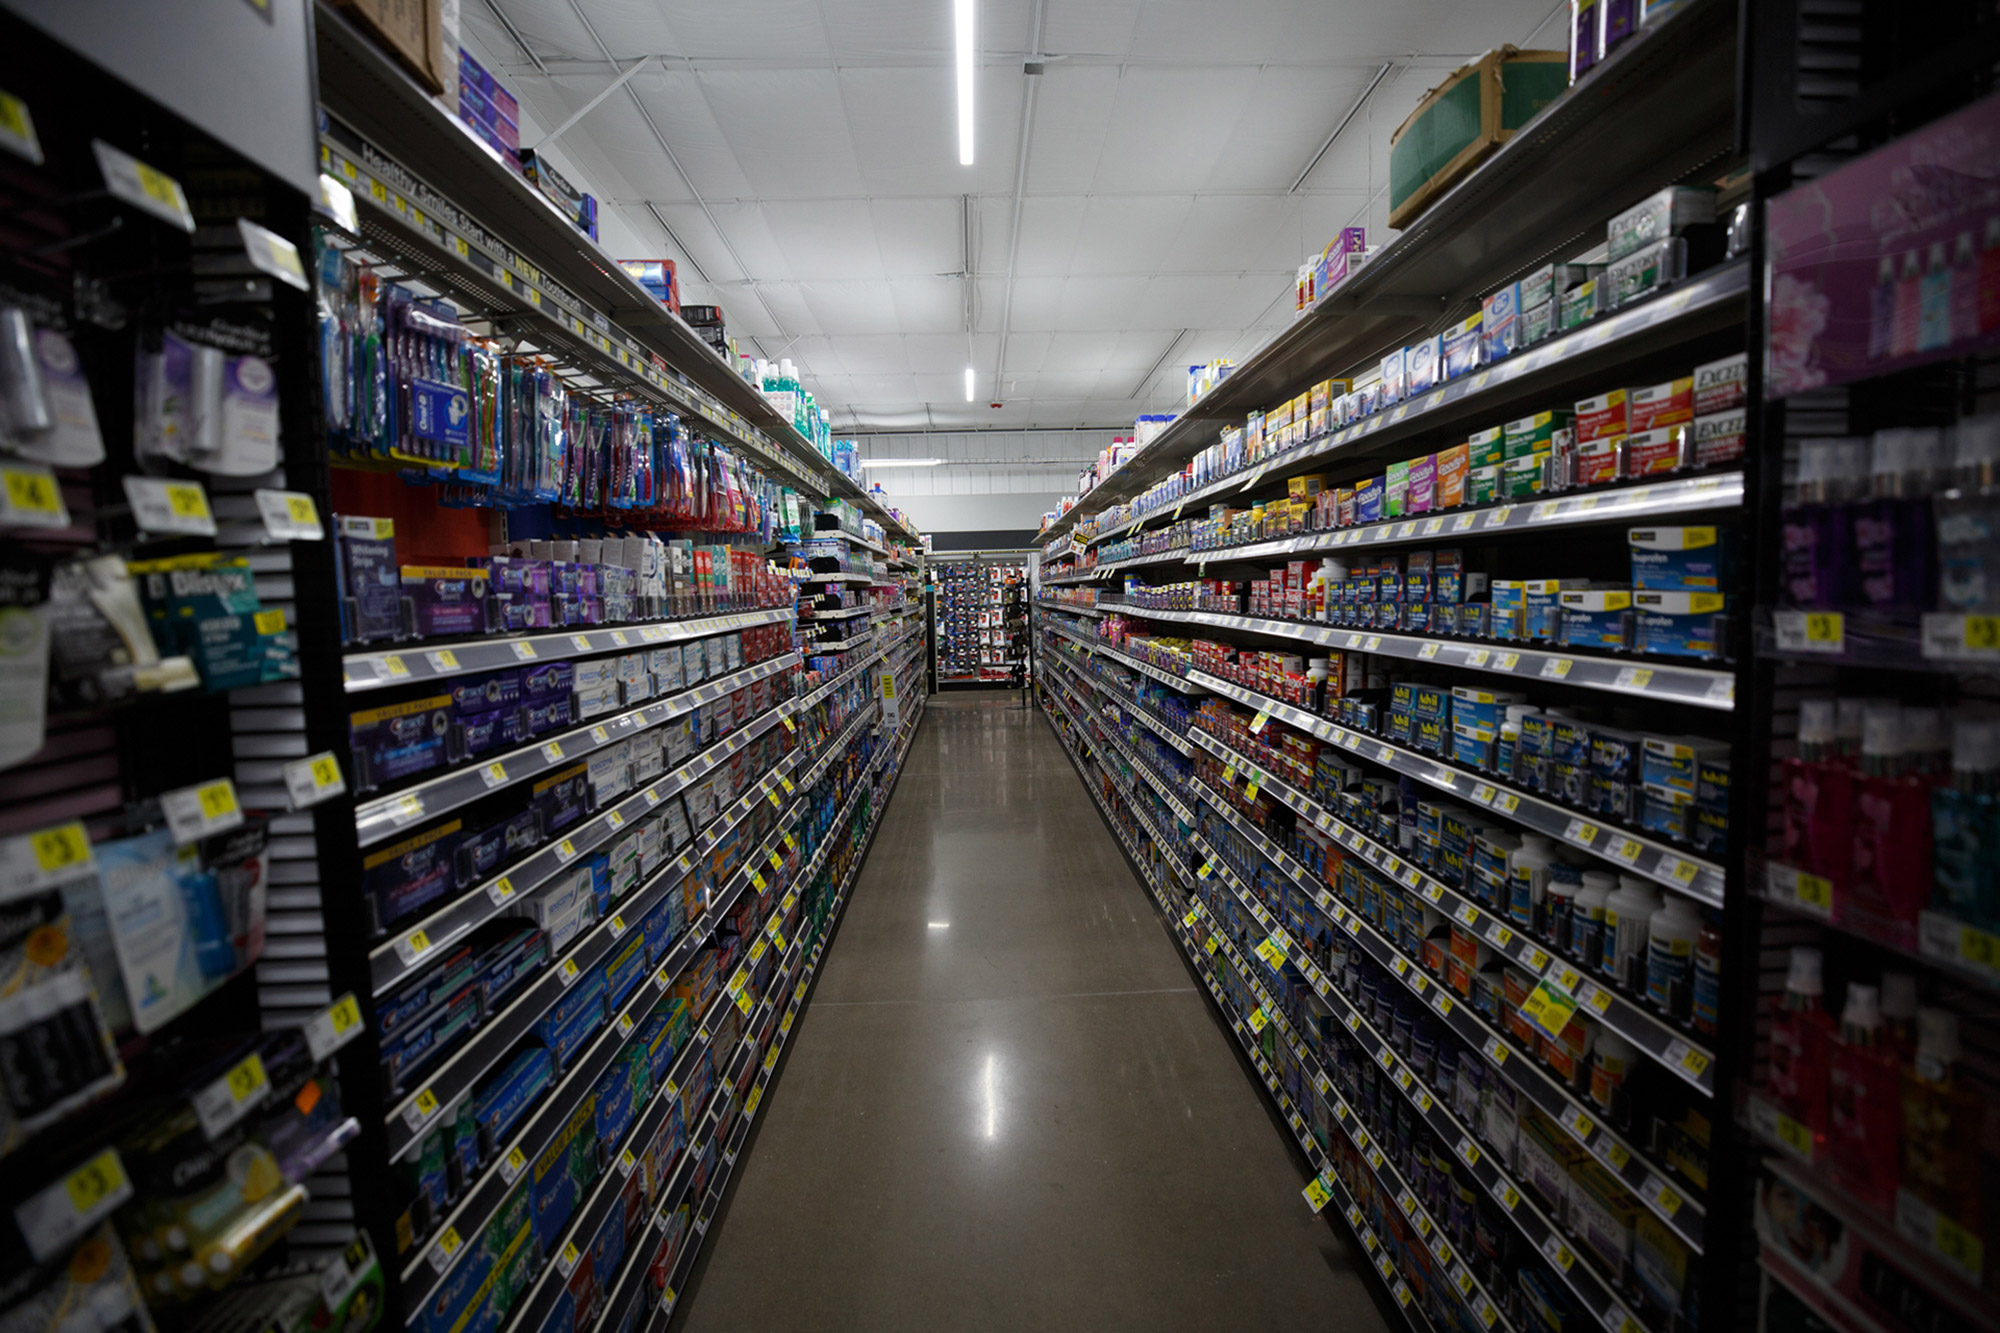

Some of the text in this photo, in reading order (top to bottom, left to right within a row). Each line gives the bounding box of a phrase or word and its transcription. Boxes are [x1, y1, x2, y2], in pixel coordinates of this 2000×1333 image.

[362, 142, 418, 196] Healthy
[418, 184, 459, 226] Smiles
[459, 213, 485, 246] Start
[484, 234, 507, 260] with
[515, 254, 541, 284] NEW
[434, 580, 465, 595] Crest
[525, 674, 550, 690] Crest
[453, 685, 486, 702] Crest
[1394, 686, 1411, 701] Advil
[1419, 693, 1439, 707] Advil
[389, 714, 426, 734] Crest
[1393, 713, 1410, 728] Advil
[1523, 719, 1542, 733] Advil
[466, 722, 493, 738] Crest
[1420, 721, 1441, 737] Advil
[1701, 768, 1729, 787] Advil
